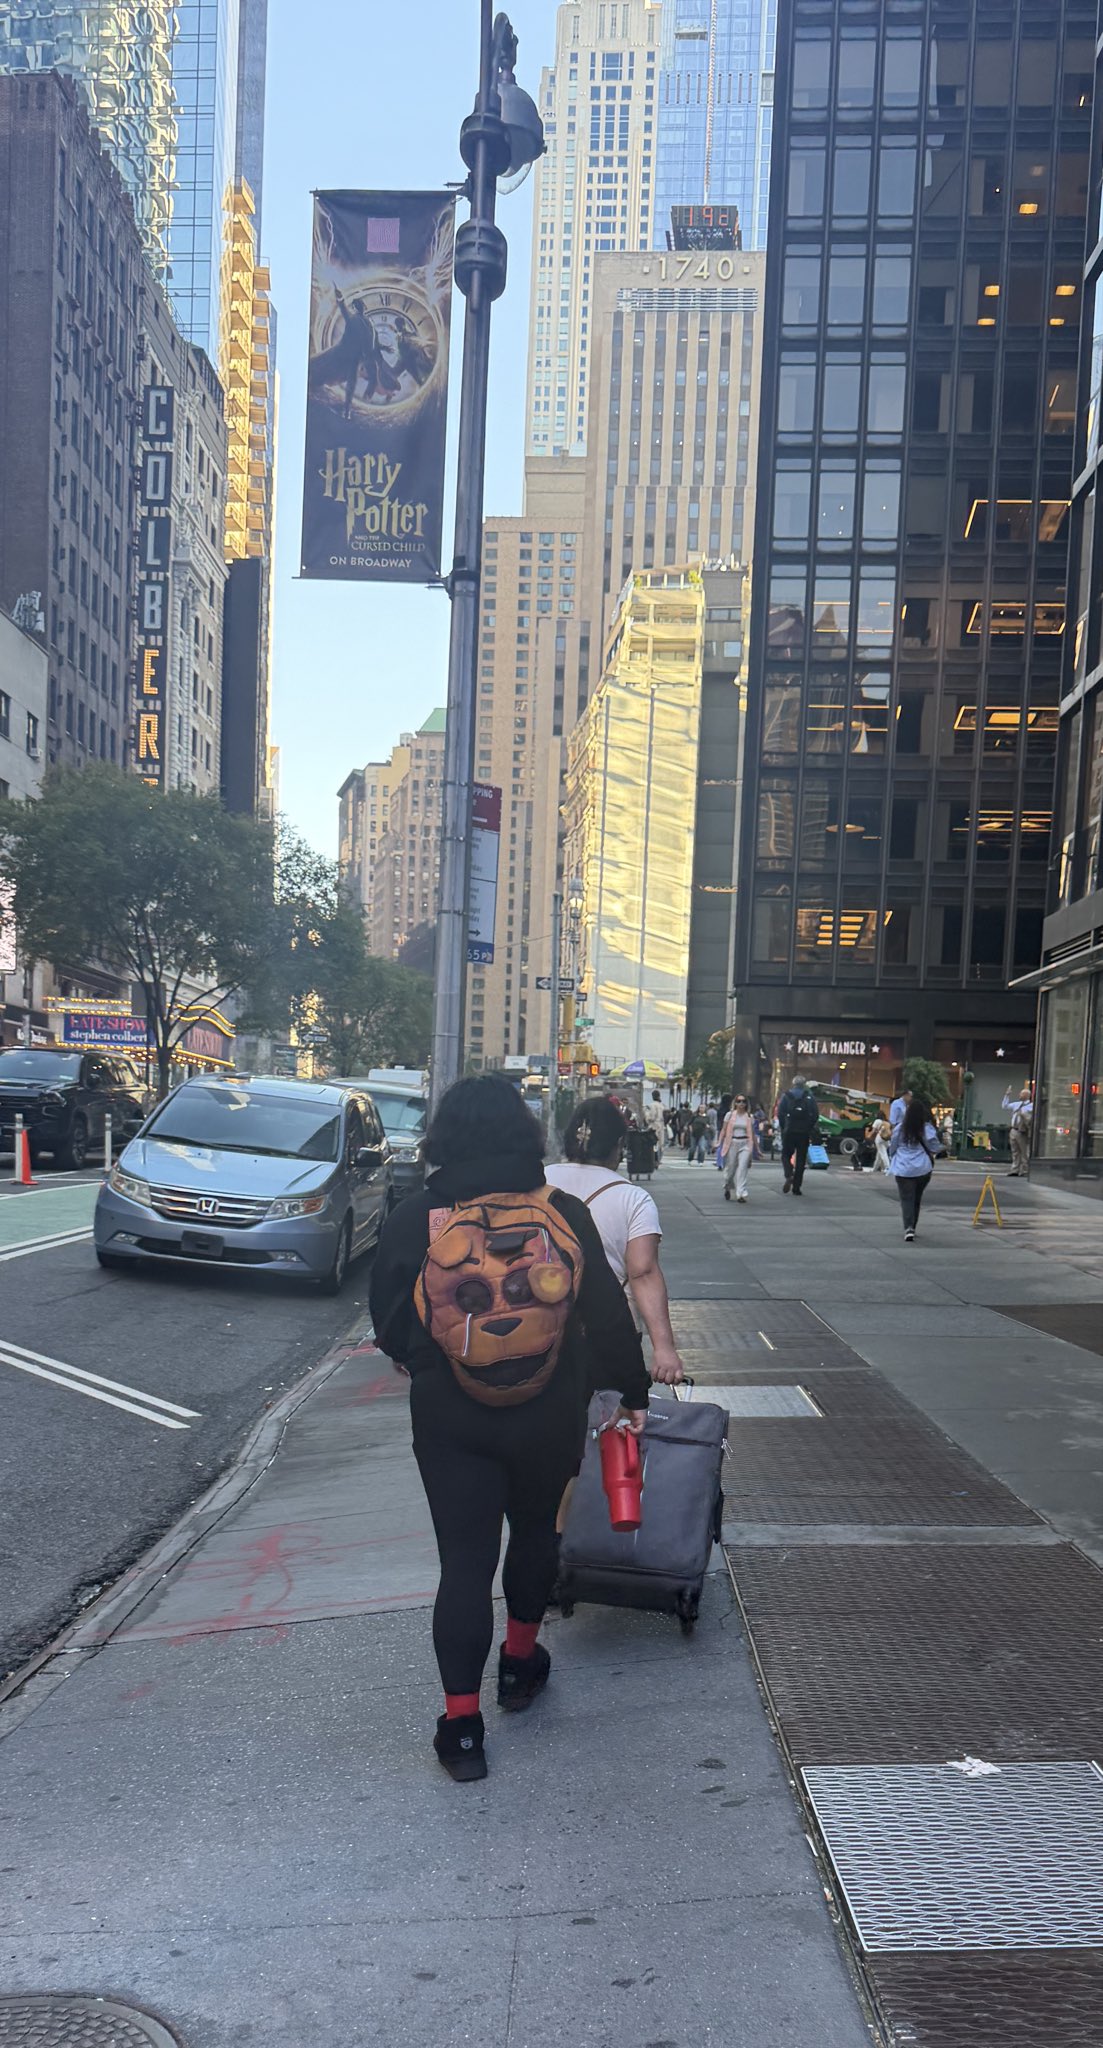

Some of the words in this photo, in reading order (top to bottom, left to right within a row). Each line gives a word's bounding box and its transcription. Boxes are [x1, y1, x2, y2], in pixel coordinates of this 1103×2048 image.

[659, 256, 734, 280] 1740
[318, 447, 402, 502] Harry
[346, 487, 429, 543] Potter
[351, 541, 391, 552] CURSED
[392, 541, 426, 552] CHILD
[329, 556, 347, 565] ON
[350, 556, 412, 568] BROADWAY
[139, 389, 167, 786] COLBER
[70, 1016, 104, 1030] LATE
[107, 1016, 146, 1032] SHOW
[70, 1030, 111, 1042] stephen
[112, 1030, 147, 1042] colbert
[797, 1039, 819, 1054] PRET
[821, 1041, 828, 1054] A
[830, 1041, 866, 1055] MANGER
